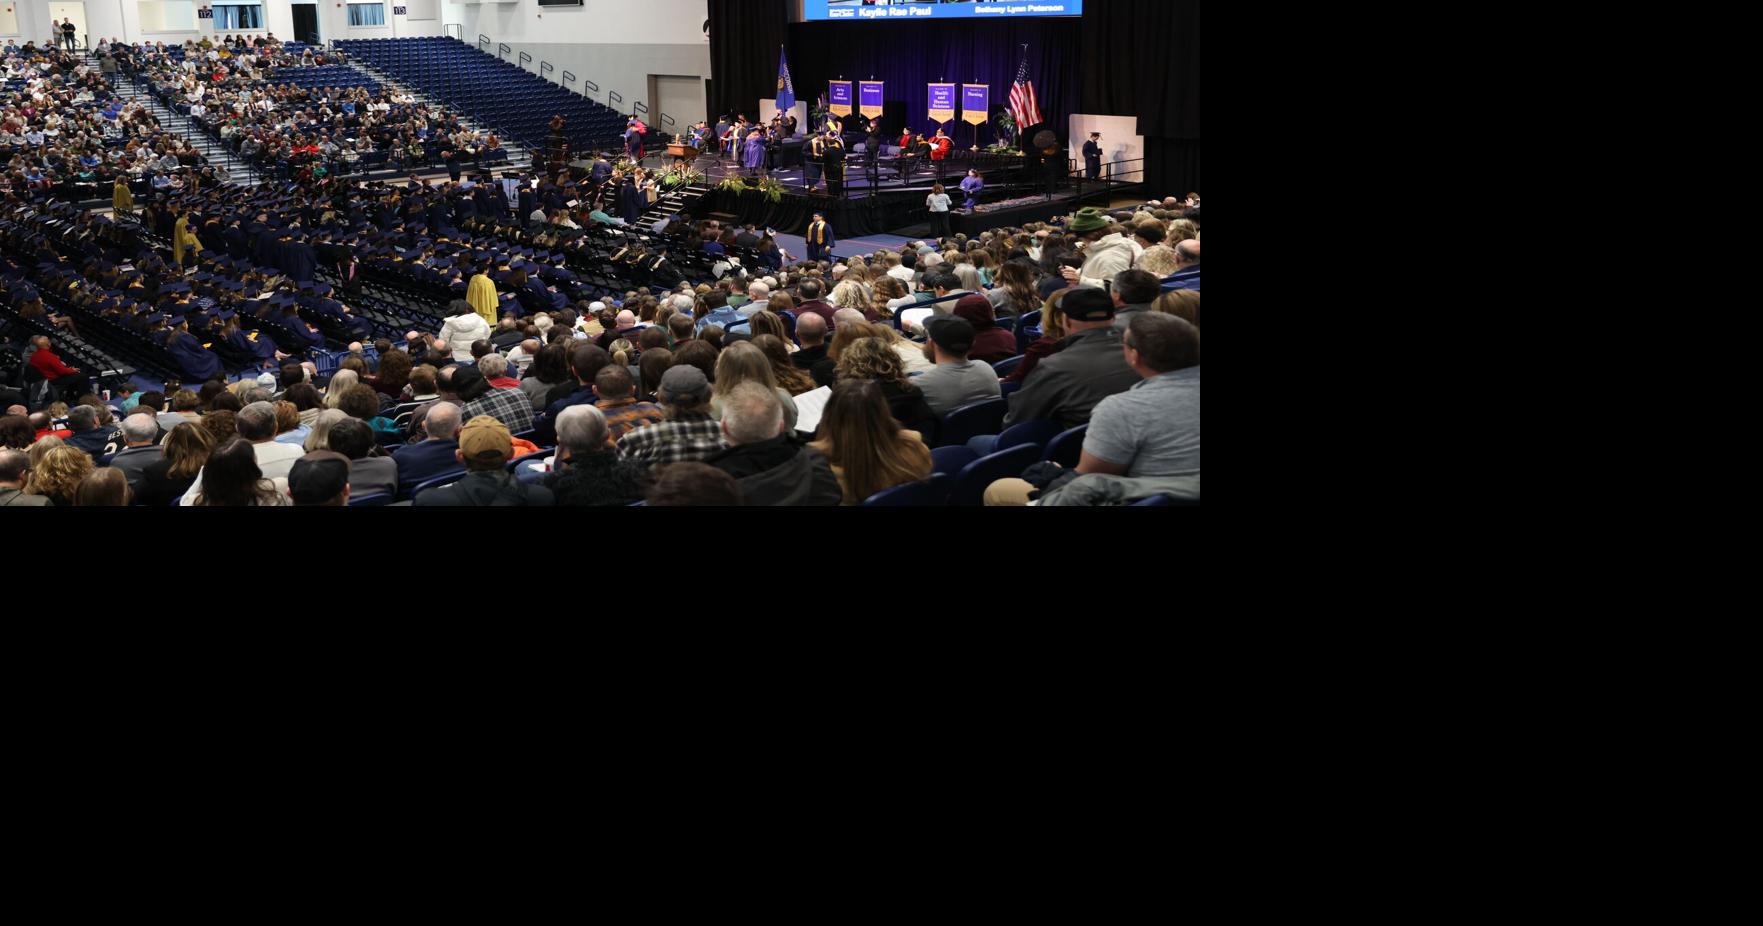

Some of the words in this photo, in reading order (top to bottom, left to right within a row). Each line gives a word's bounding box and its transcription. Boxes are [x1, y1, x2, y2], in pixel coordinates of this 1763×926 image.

[858, 7, 887, 18] Kaylie
[889, 7, 907, 16] Rae
[909, 6, 932, 16] Paul
[1006, 5, 1026, 14] Lynn
